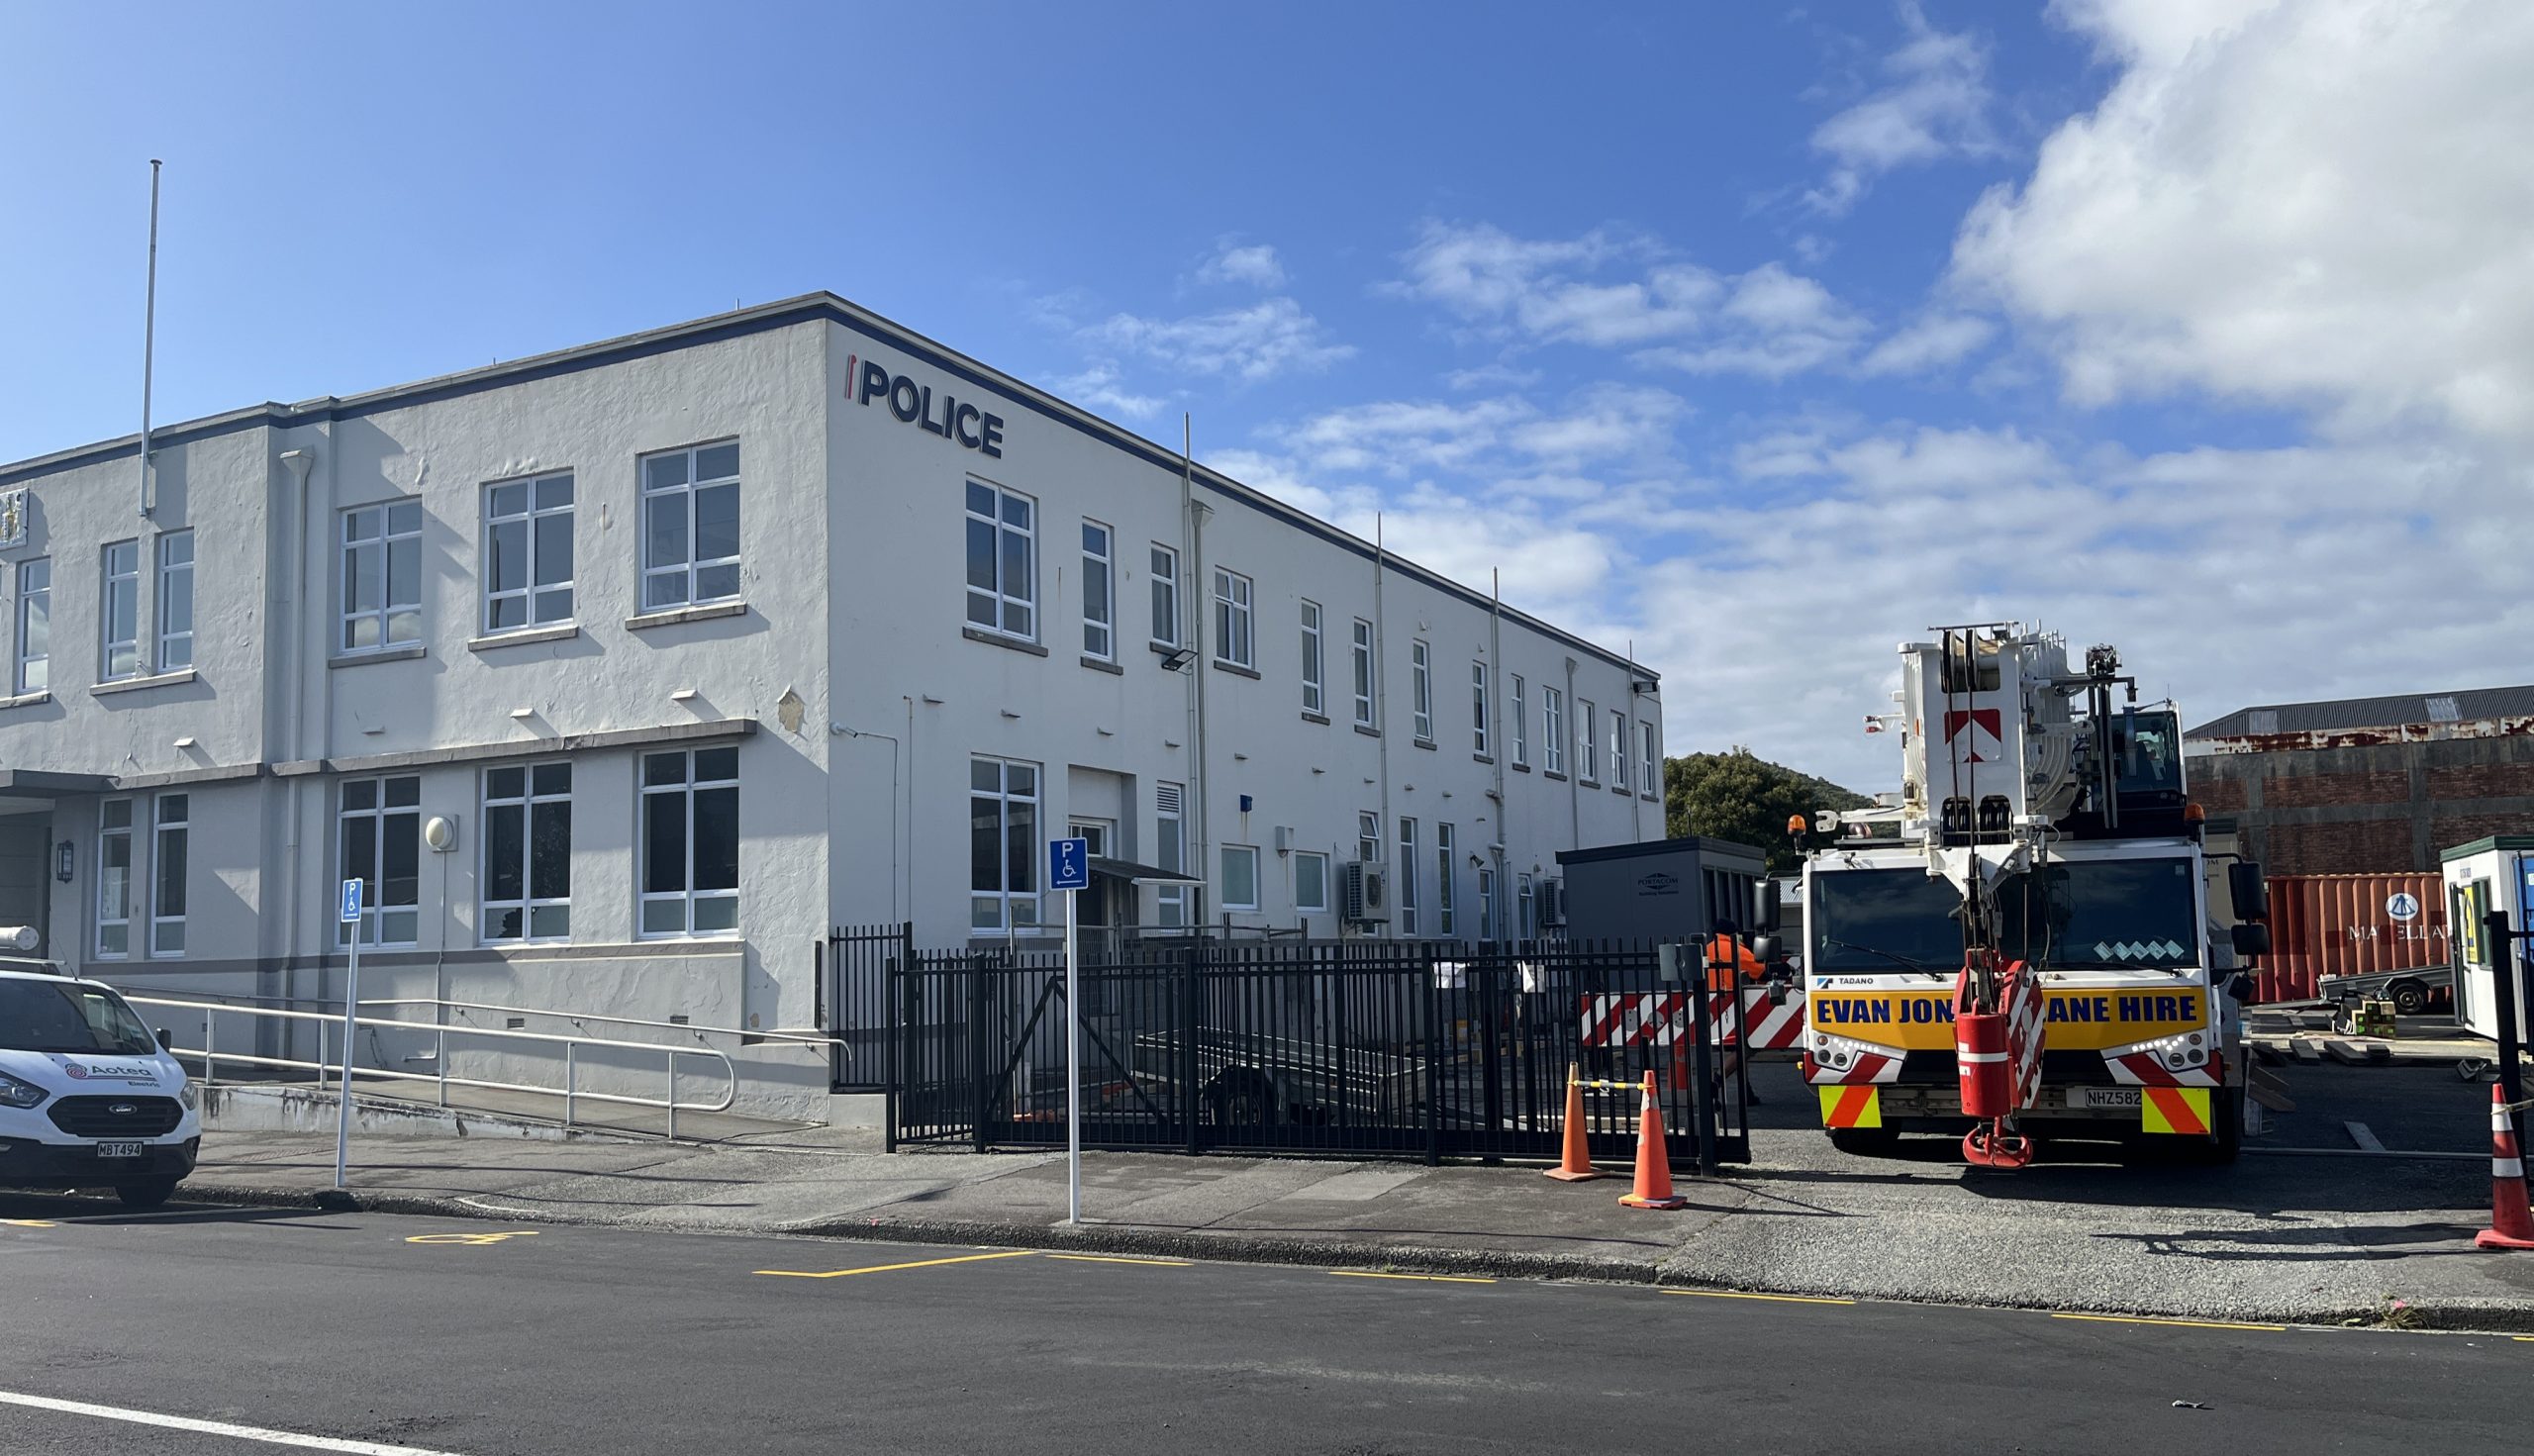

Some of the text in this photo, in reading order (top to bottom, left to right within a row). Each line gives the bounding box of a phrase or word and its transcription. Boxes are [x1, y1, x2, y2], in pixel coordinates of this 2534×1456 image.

[859, 359, 1004, 459] POLICE
[1062, 842, 1074, 858] P
[349, 882, 356, 896] P
[2349, 924, 2452, 940] MAELLA
[1816, 996, 2196, 1023] EVAN JON ANE HIRE
[92, 1065, 152, 1076] Aotea
[2088, 1092, 2142, 1105] NHZ582
[99, 1144, 141, 1156] MBT494
